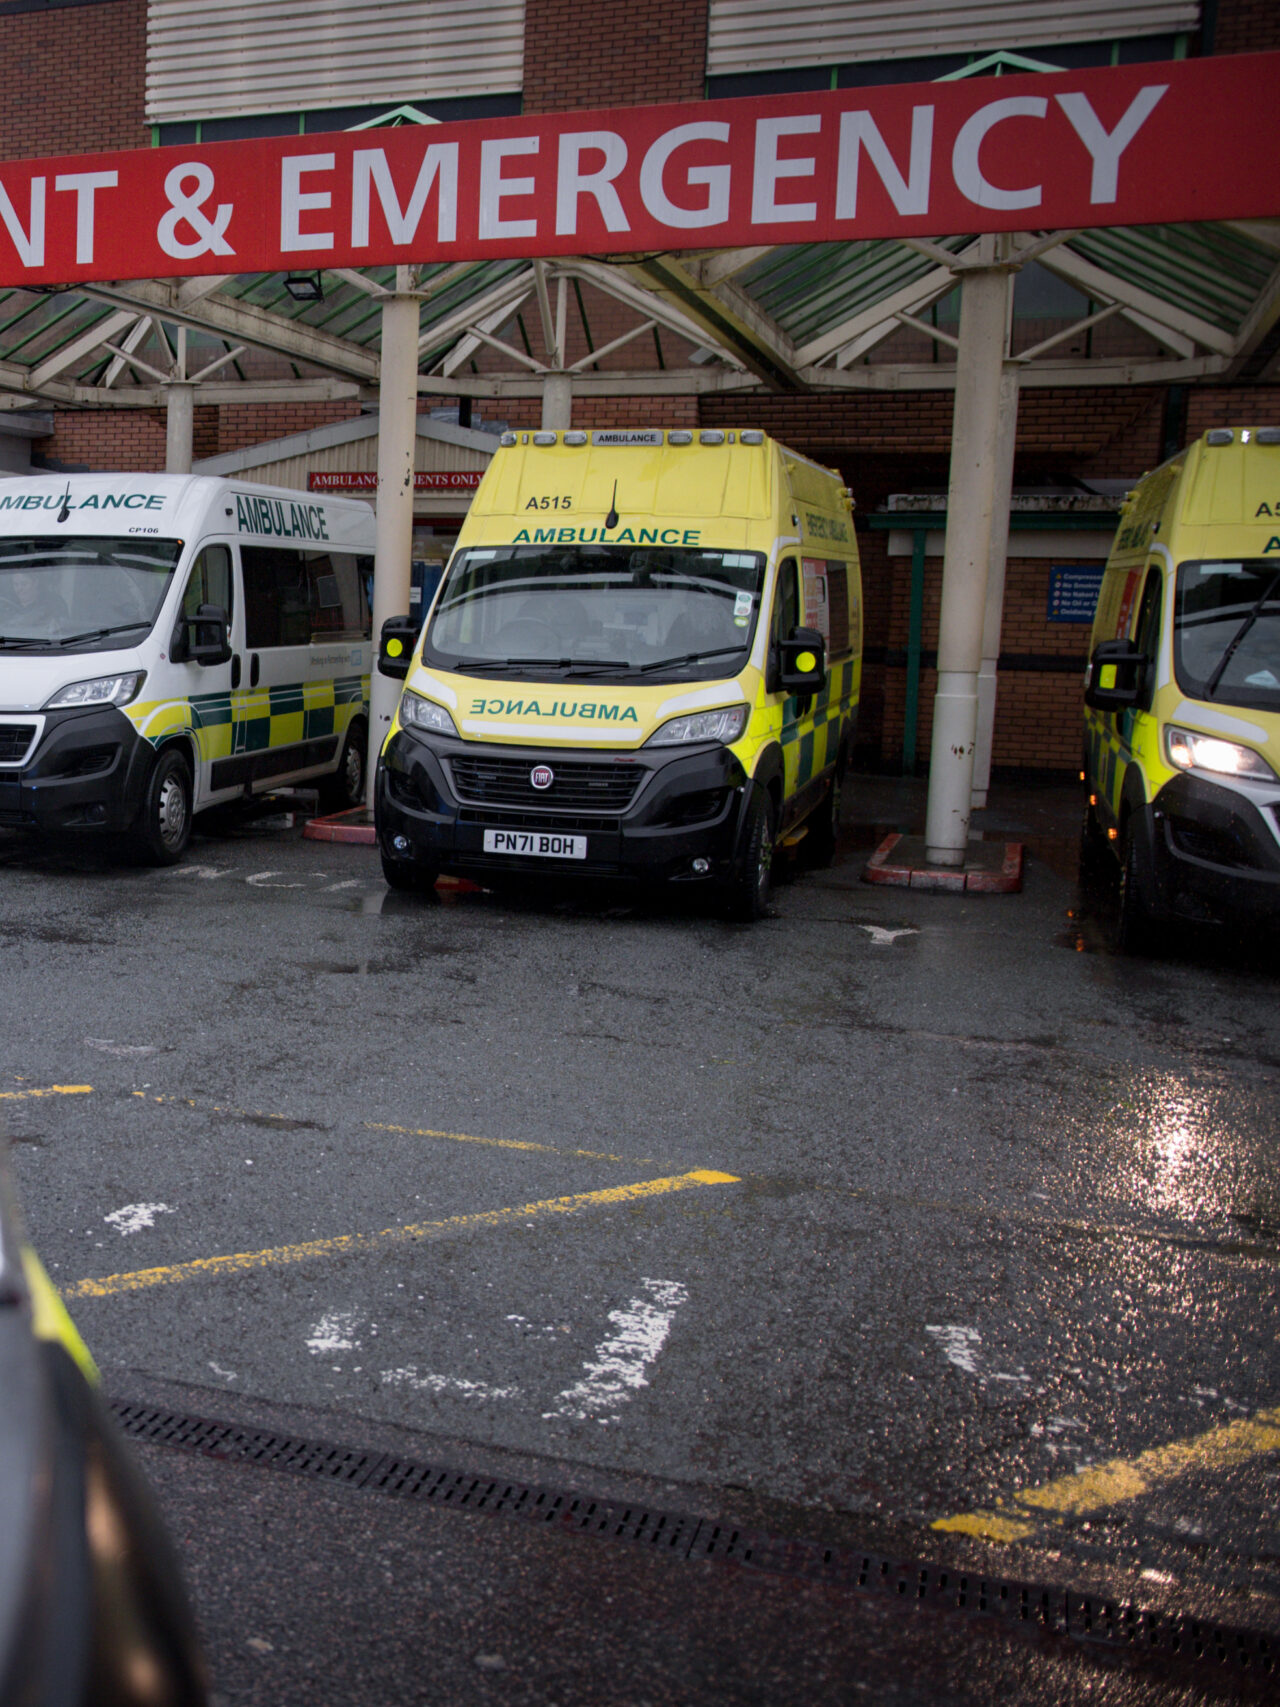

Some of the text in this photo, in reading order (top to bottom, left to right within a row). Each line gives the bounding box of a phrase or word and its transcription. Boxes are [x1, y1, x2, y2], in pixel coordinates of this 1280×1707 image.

[156, 161, 237, 260] &
[280, 84, 1170, 253] EMERGENCY
[598, 434, 657, 443] AMBULANCE
[314, 475, 379, 486] AMBULANC
[451, 475, 483, 485] ONLY
[525, 496, 572, 511] A515
[236, 495, 330, 541] AMBULANCE
[512, 528, 702, 546] AMBULANCE
[535, 772, 549, 784] FIAT
[494, 833, 574, 854] PN71 BOH
